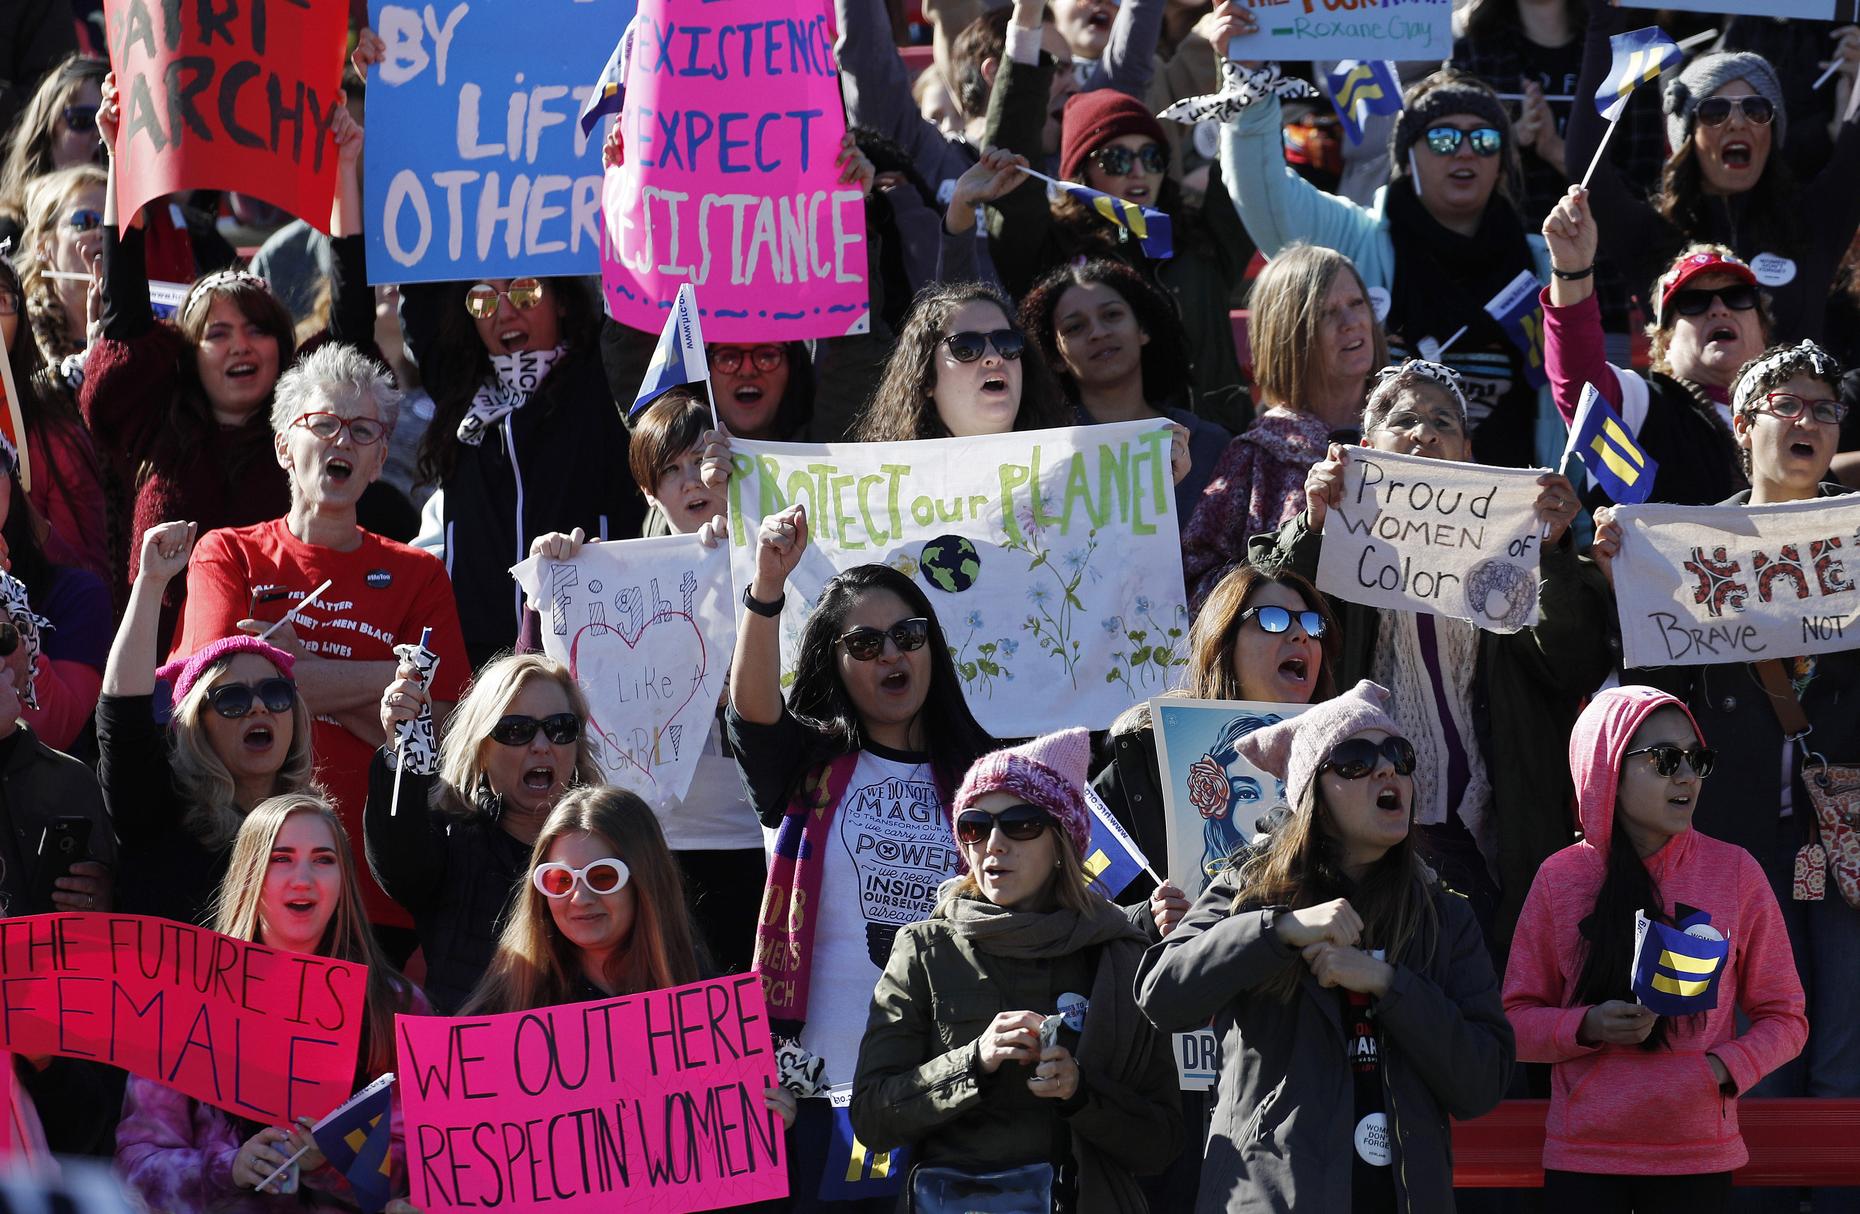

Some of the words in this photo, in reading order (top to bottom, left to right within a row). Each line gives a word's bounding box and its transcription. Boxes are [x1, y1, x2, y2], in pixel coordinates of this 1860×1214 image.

[378, 2, 470, 87] BY
[638, 14, 837, 81] EXISTENCE
[125, 57, 338, 174] ARCHY
[638, 105, 824, 174] EXPECT
[383, 168, 602, 268] OTHER
[604, 183, 865, 286] RESISTANCE
[729, 452, 912, 550] PROTECT
[911, 495, 988, 527] our
[998, 430, 1173, 546] PLANET
[1354, 459, 1498, 519] Proud
[1337, 508, 1485, 550] WOMEN
[1508, 535, 1536, 557] OF
[1358, 545, 1460, 599] Color
[1683, 526, 1860, 617] #ME
[551, 564, 697, 644] Fight
[1802, 615, 1849, 643] NOT
[322, 641, 353, 658] LIVES
[690, 664, 710, 698] A
[848, 809, 860, 818] TO
[864, 814, 920, 831] TRANSFORM
[867, 786, 884, 799] WE
[888, 780, 903, 800] DO
[905, 784, 930, 804] NOT
[856, 833, 960, 873] POWER
[865, 823, 881, 832] we
[885, 828, 917, 843] carry
[920, 832, 936, 841] all
[864, 891, 935, 914] OURSELVES
[866, 875, 938, 903] INSIDE
[878, 867, 898, 878] we
[900, 871, 934, 885] need
[0, 917, 86, 975] THE
[109, 919, 275, 1015] FUTURE
[284, 958, 351, 1031] IS
[2, 976, 339, 1124] FEMALE
[401, 1022, 498, 1102] WE
[514, 1001, 632, 1096] OUT
[643, 977, 764, 1077] HERE
[418, 1098, 630, 1209] RESPECTIN'
[634, 1075, 778, 1188] WOMEN
